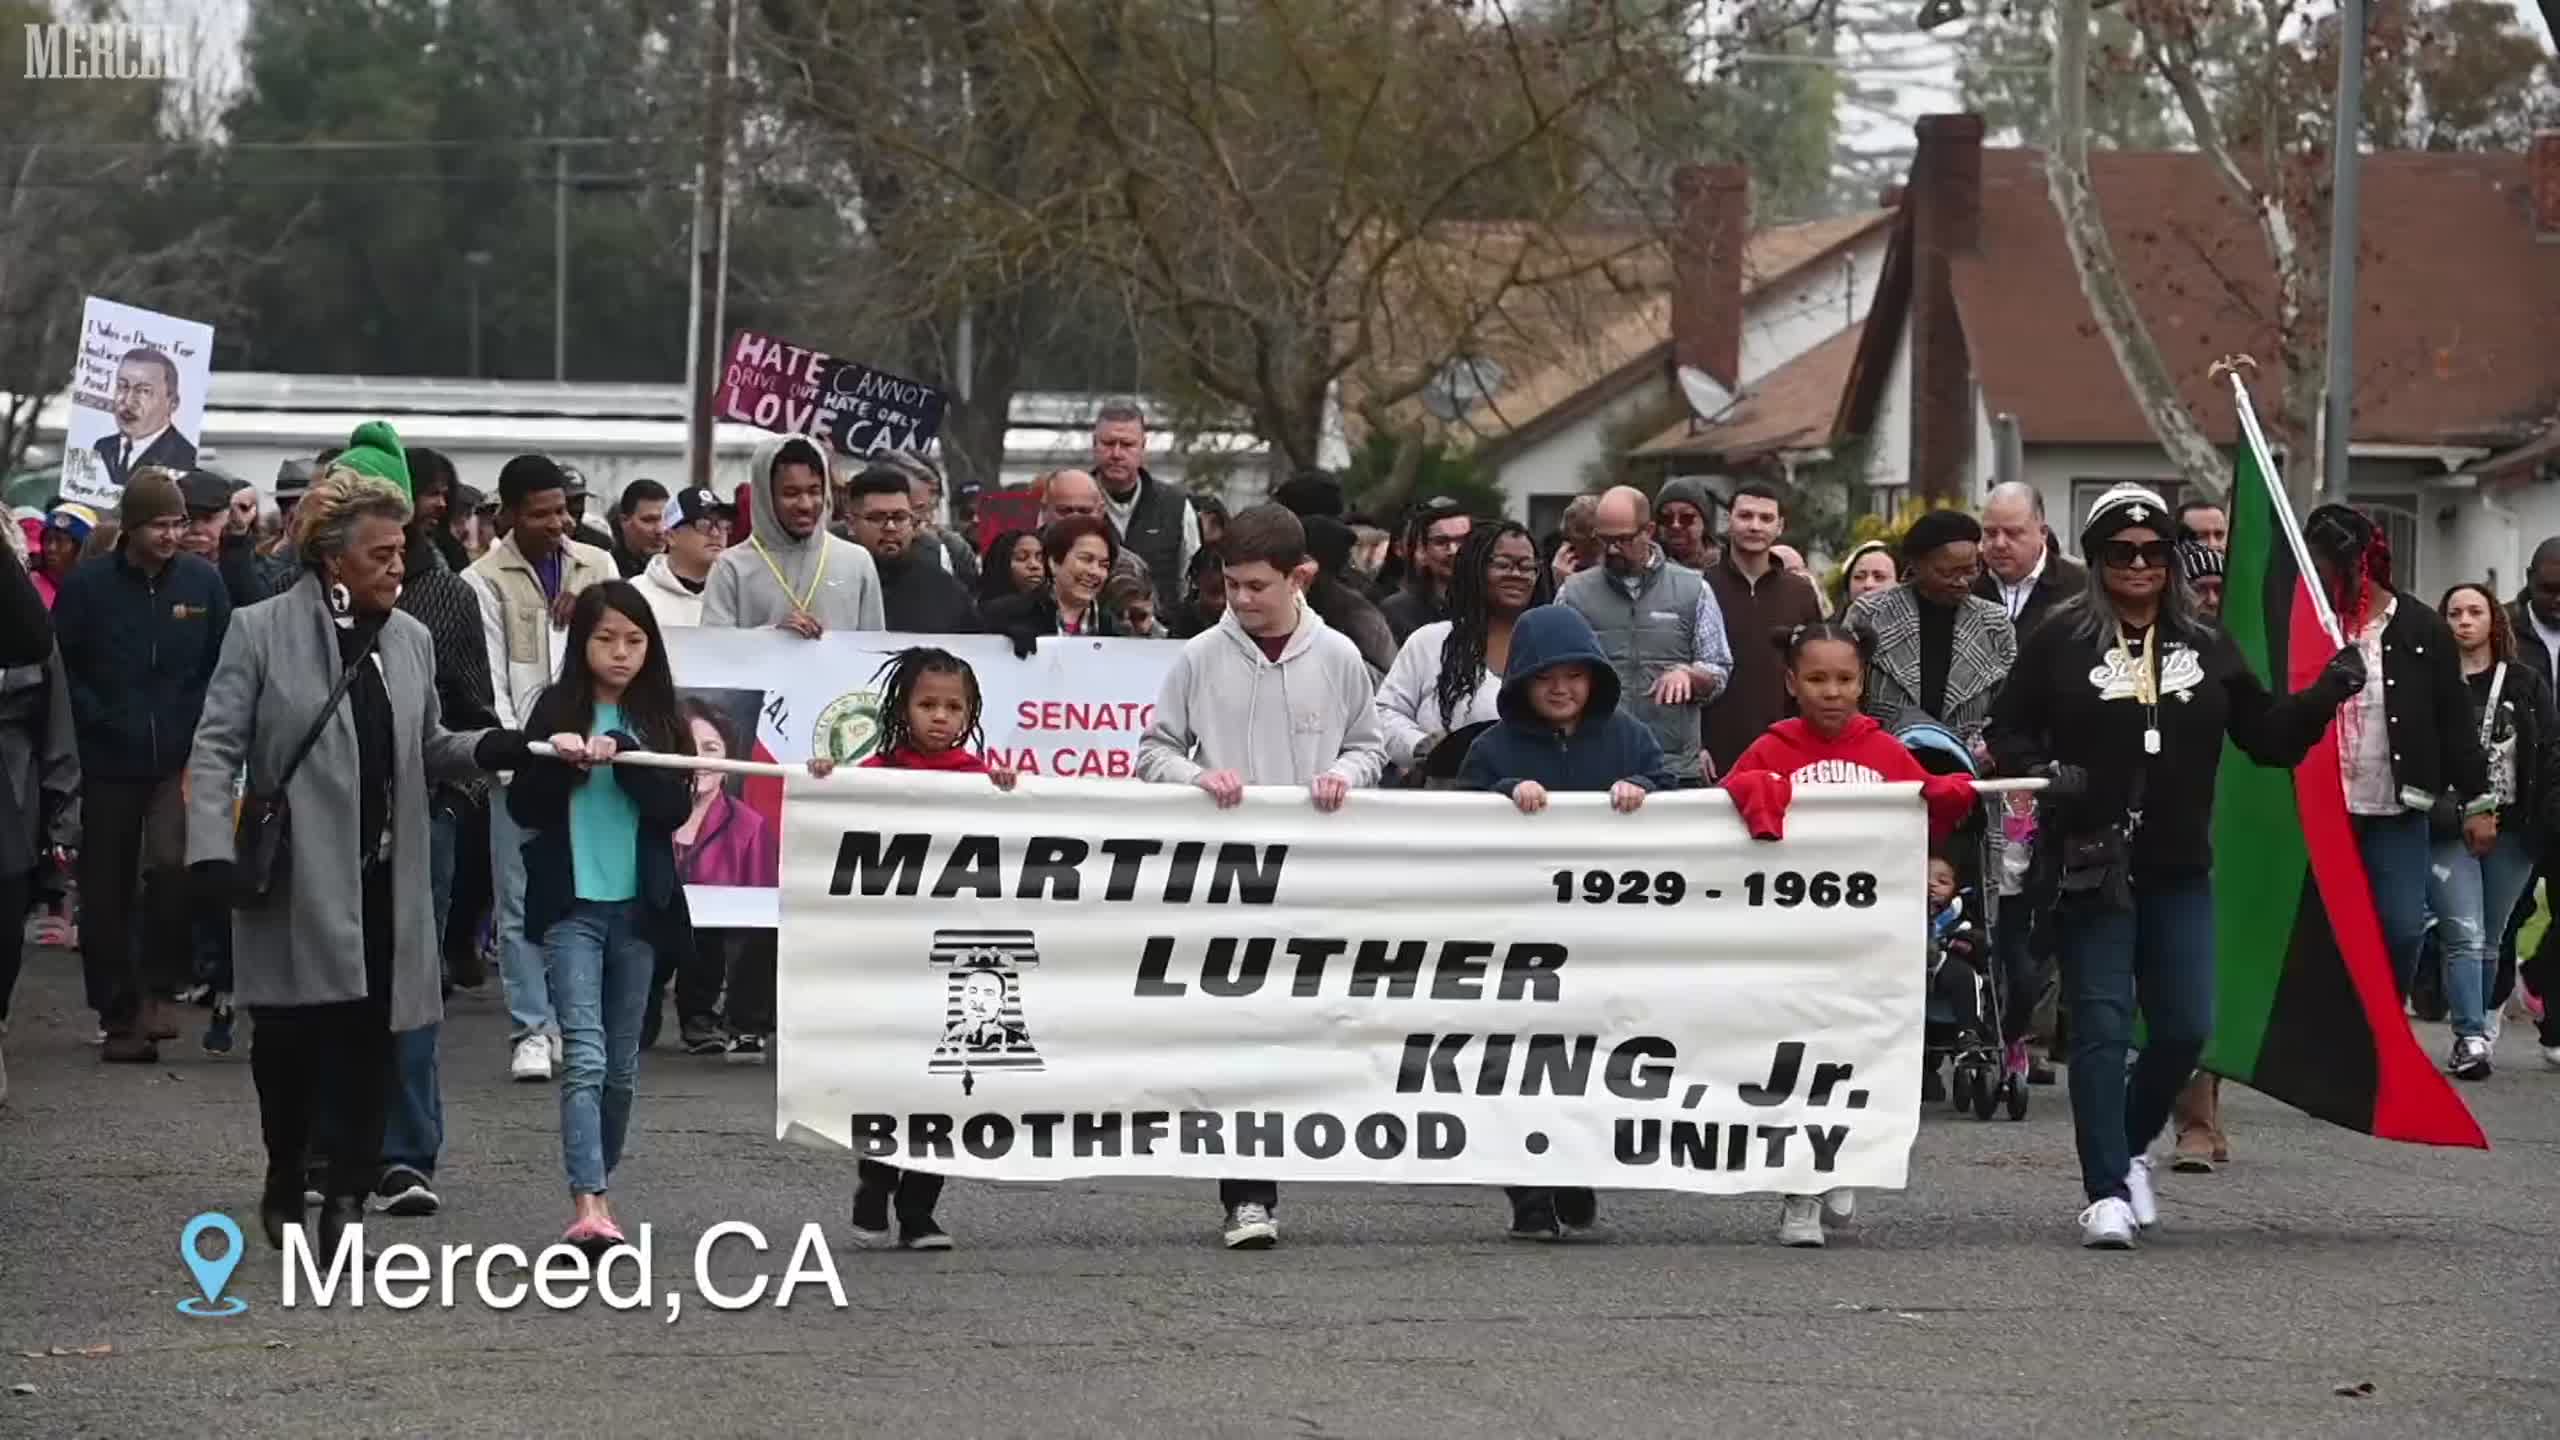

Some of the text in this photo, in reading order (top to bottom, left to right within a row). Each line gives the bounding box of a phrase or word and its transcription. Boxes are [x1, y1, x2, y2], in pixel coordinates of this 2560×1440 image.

[727, 364, 921, 430] DRIVE OUT HATE ONLY
[736, 332, 935, 408] HATE CANNOT
[727, 383, 839, 444] LOVE
[986, 747, 1137, 778] NA CAB
[829, 831, 1288, 905] MARTIN
[1553, 870, 1686, 905] 1929
[1744, 872, 1877, 907] 1968
[1135, 936, 1568, 1001] LUTHER
[1396, 1033, 1869, 1108] KING, Jr.
[1614, 1119, 1849, 1172] UNITY
